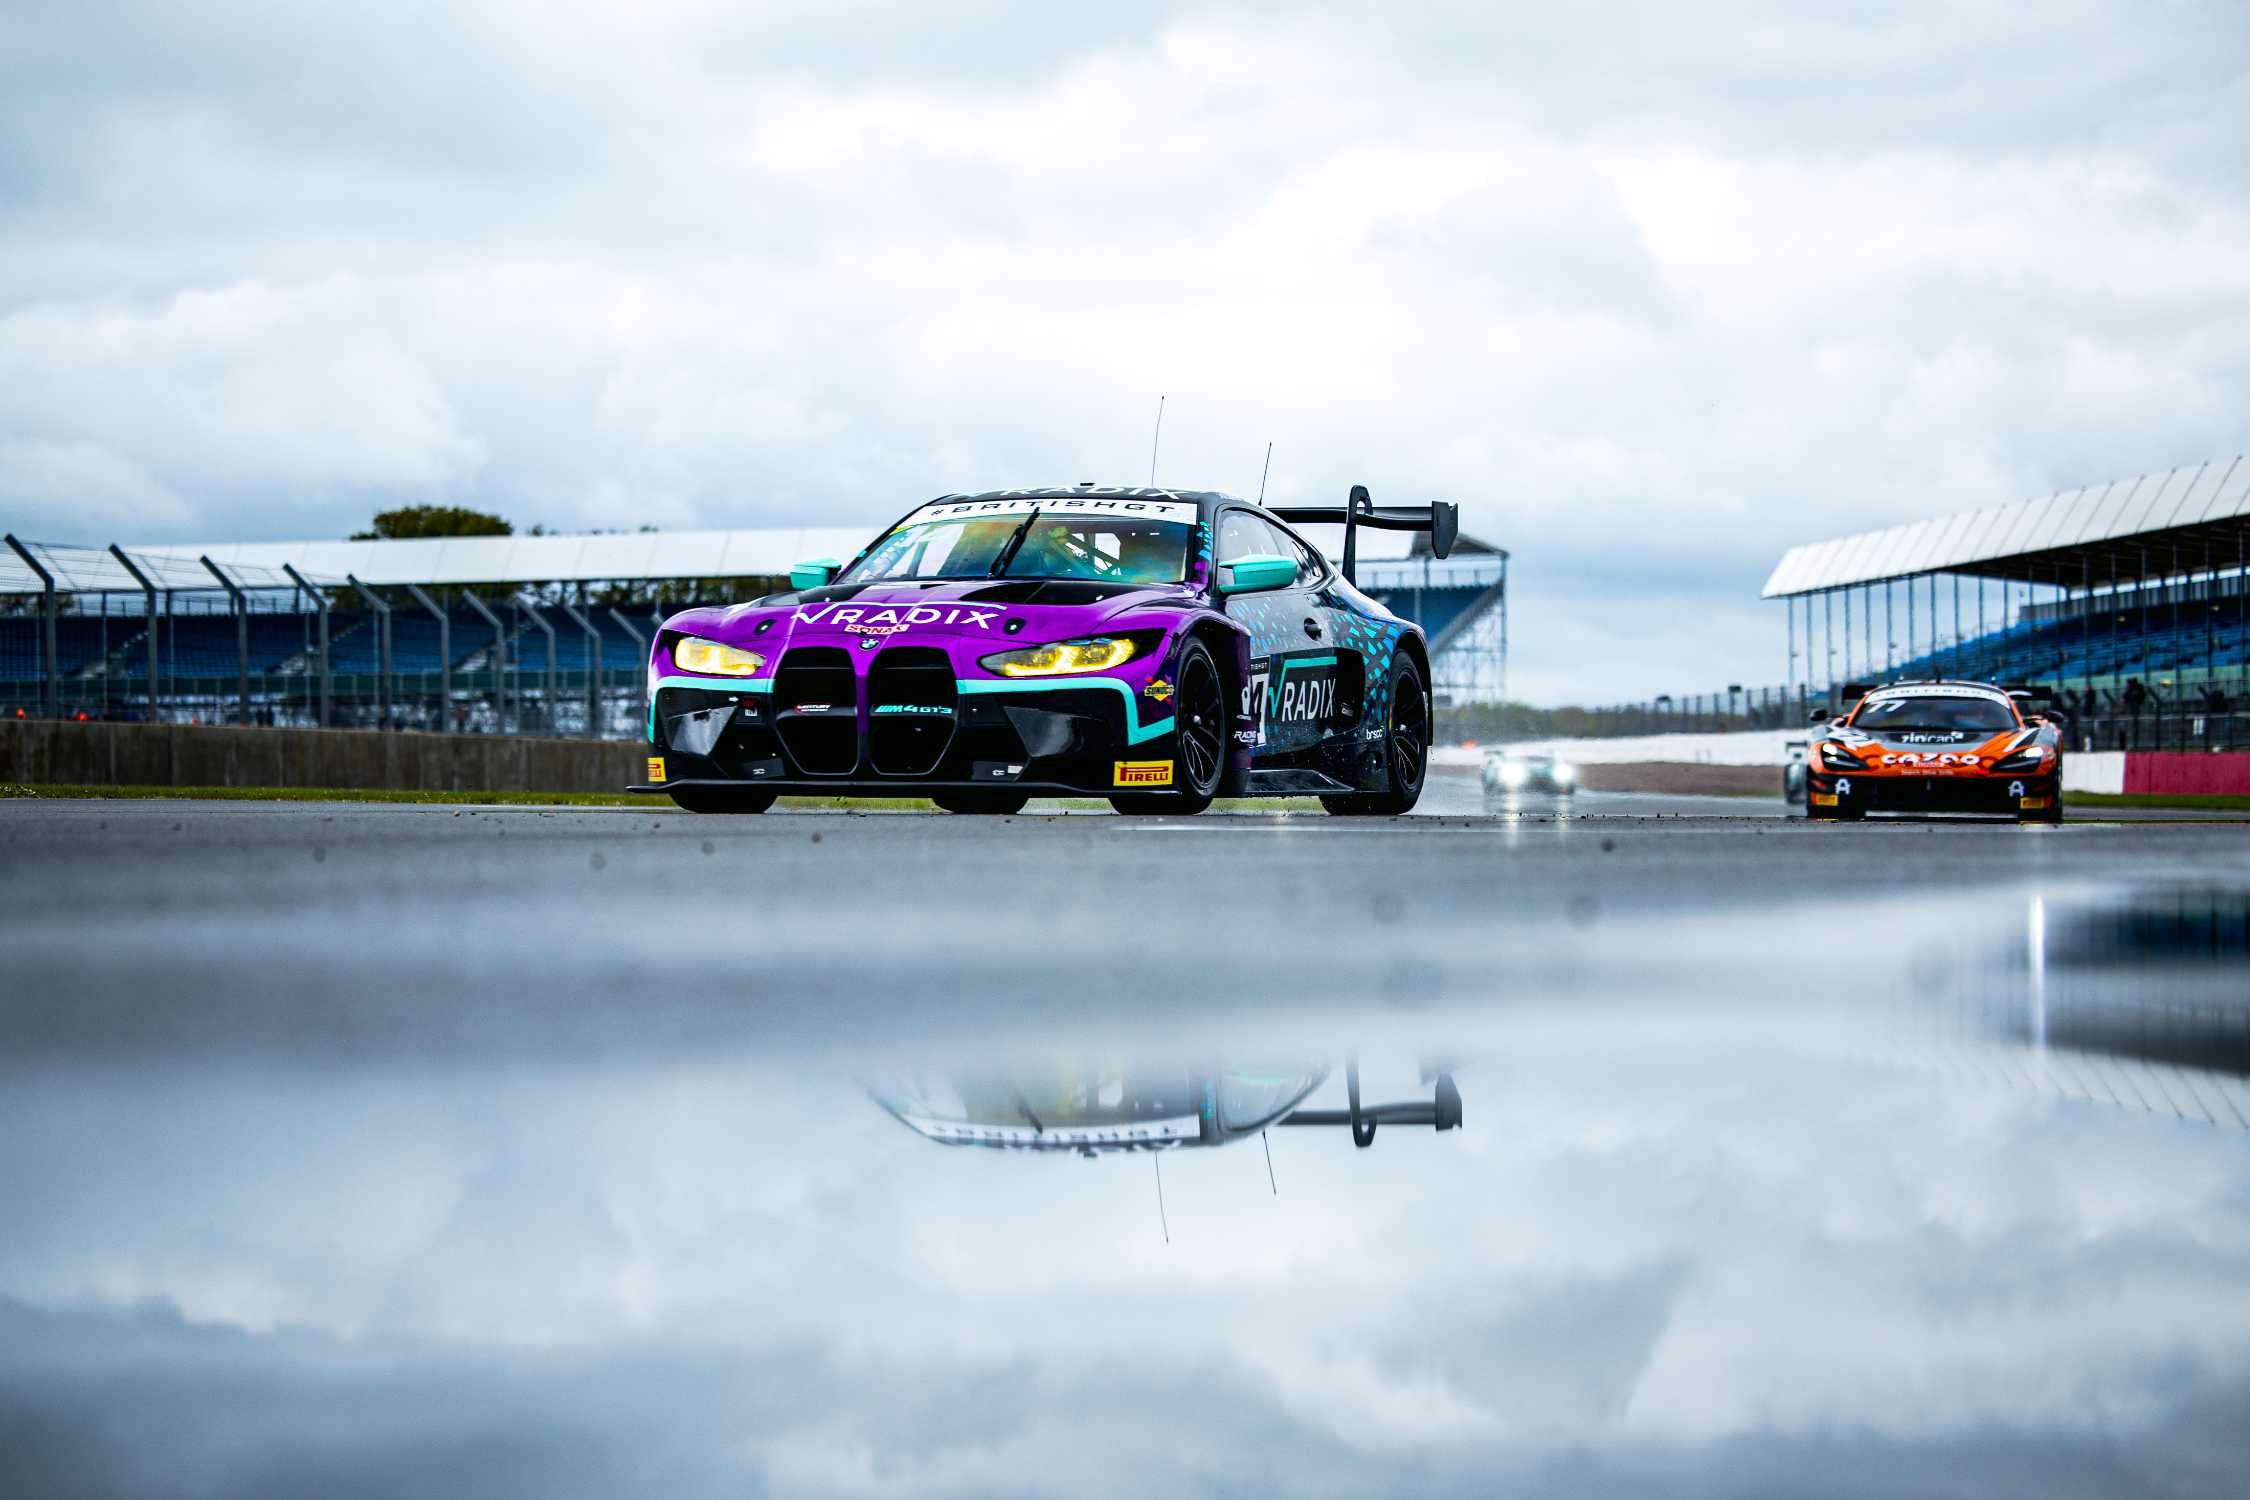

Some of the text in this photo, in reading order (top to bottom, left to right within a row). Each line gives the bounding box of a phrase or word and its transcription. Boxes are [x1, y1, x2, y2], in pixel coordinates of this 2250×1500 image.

[830, 608, 999, 629] RADIX
[1282, 679, 1336, 722] RADIX
[1866, 700, 1906, 713] 77
[1120, 766, 1169, 782] PIRELLI
